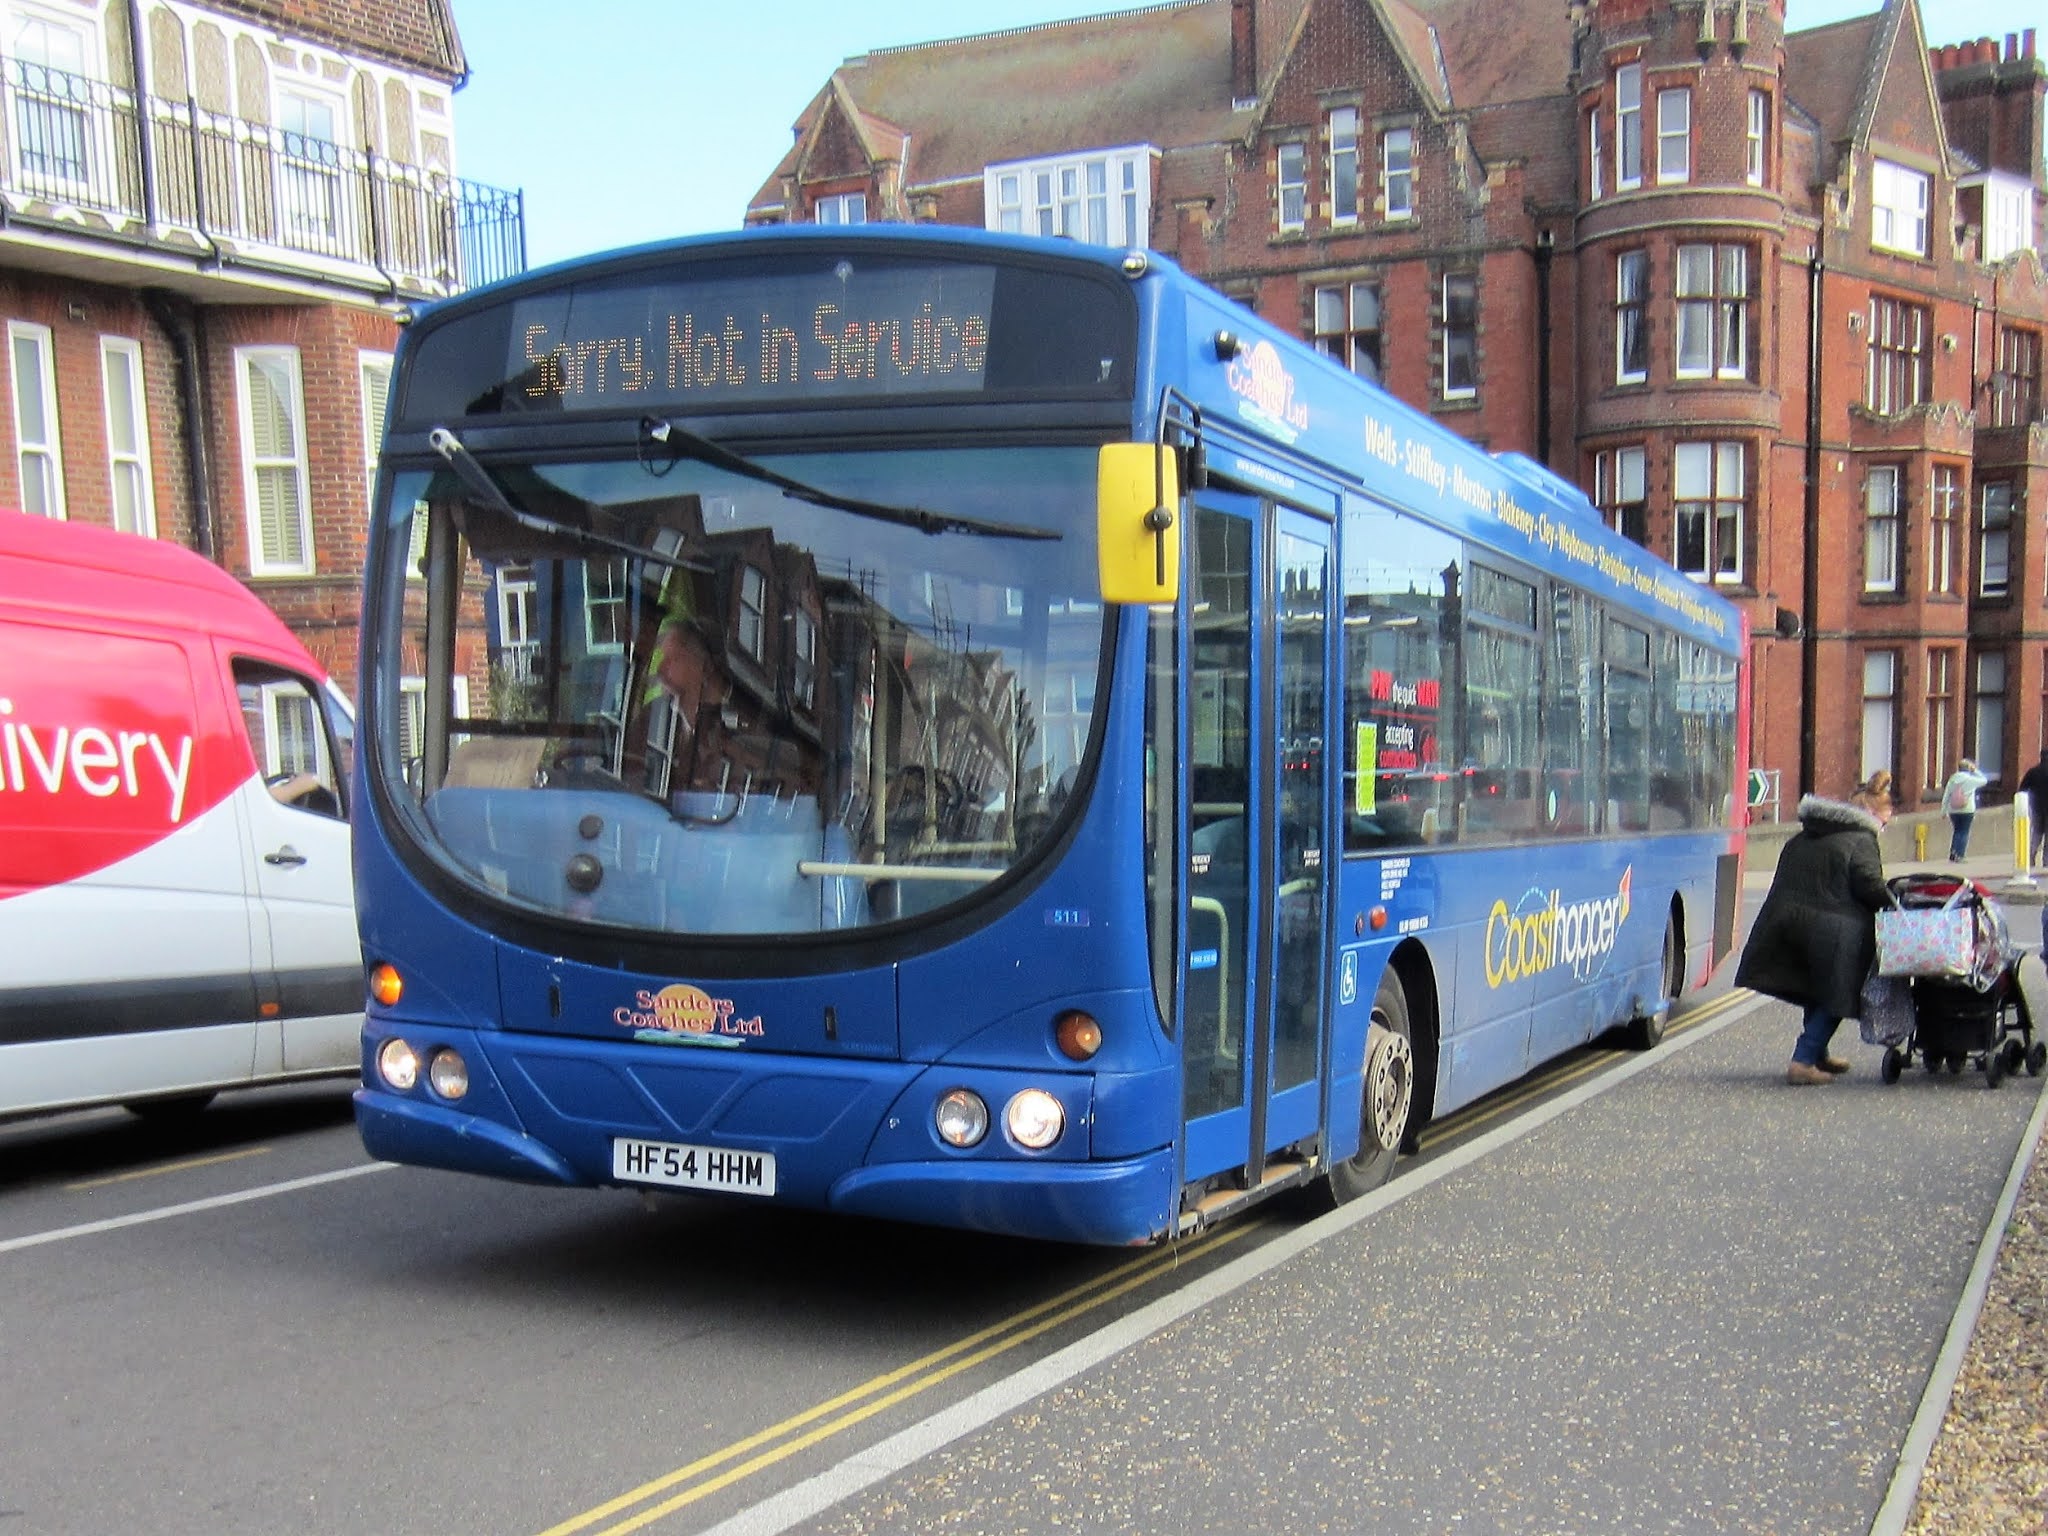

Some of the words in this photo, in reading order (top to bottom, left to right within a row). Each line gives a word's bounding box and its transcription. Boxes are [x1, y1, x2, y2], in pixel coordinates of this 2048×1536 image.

[526, 321, 654, 397] Sorry,
[667, 313, 747, 389] Not
[761, 312, 799, 384] in
[813, 302, 988, 380] Service
[1286, 392, 1309, 431] Ltd
[1364, 414, 1398, 468] Wells
[1405, 437, 1446, 499] Stiffkey
[1453, 462, 1492, 514] Morston
[1497, 488, 1535, 545] Blakeney
[1385, 722, 1414, 750] accepting
[0, 696, 193, 824] ivery
[1053, 909, 1080, 924] 511
[1484, 887, 1622, 990] Coasthopper
[613, 1006, 715, 1033] Coaches
[719, 1013, 766, 1036] Ltd
[635, 989, 735, 1014] Sanders
[625, 1143, 699, 1181] HF54
[706, 1151, 763, 1188] HHM
